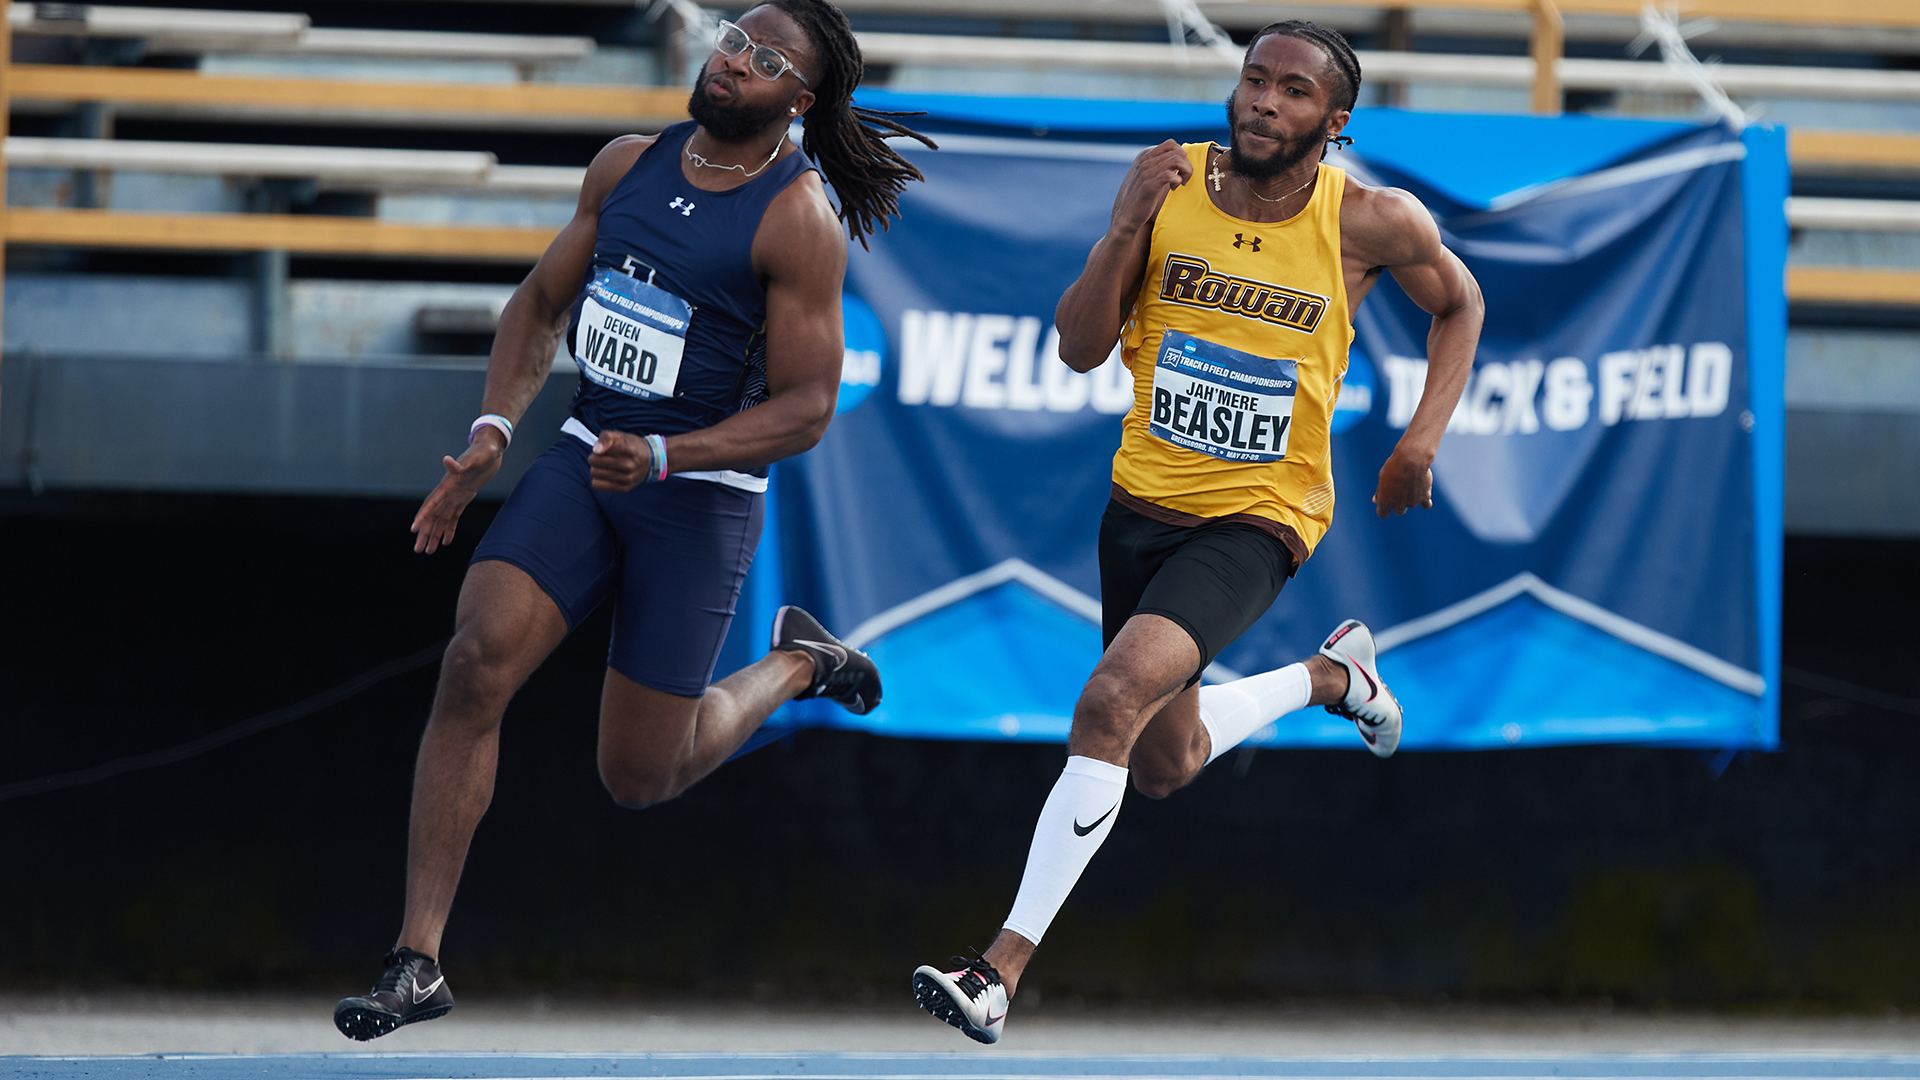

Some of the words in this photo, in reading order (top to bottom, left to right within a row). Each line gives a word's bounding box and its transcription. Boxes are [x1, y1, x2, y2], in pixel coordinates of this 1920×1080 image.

[616, 295, 634, 310] FIELD
[633, 303, 684, 329] CHAMPIONSHIPS
[1161, 254, 1327, 333] Rowan
[603, 315, 641, 342] DEVEN
[585, 324, 658, 385] WARD
[1180, 355, 1202, 370] TRACK
[1202, 363, 1209, 372] &
[1208, 365, 1230, 378] FIELD
[1229, 371, 1293, 389] CHAMPIONSHIPS
[1543, 356, 1593, 432] &
[1600, 341, 1733, 427] FIELD
[1153, 387, 1291, 452] BEASLEY
[1207, 446, 1217, 454] NC
[1226, 451, 1241, 459] MAY
